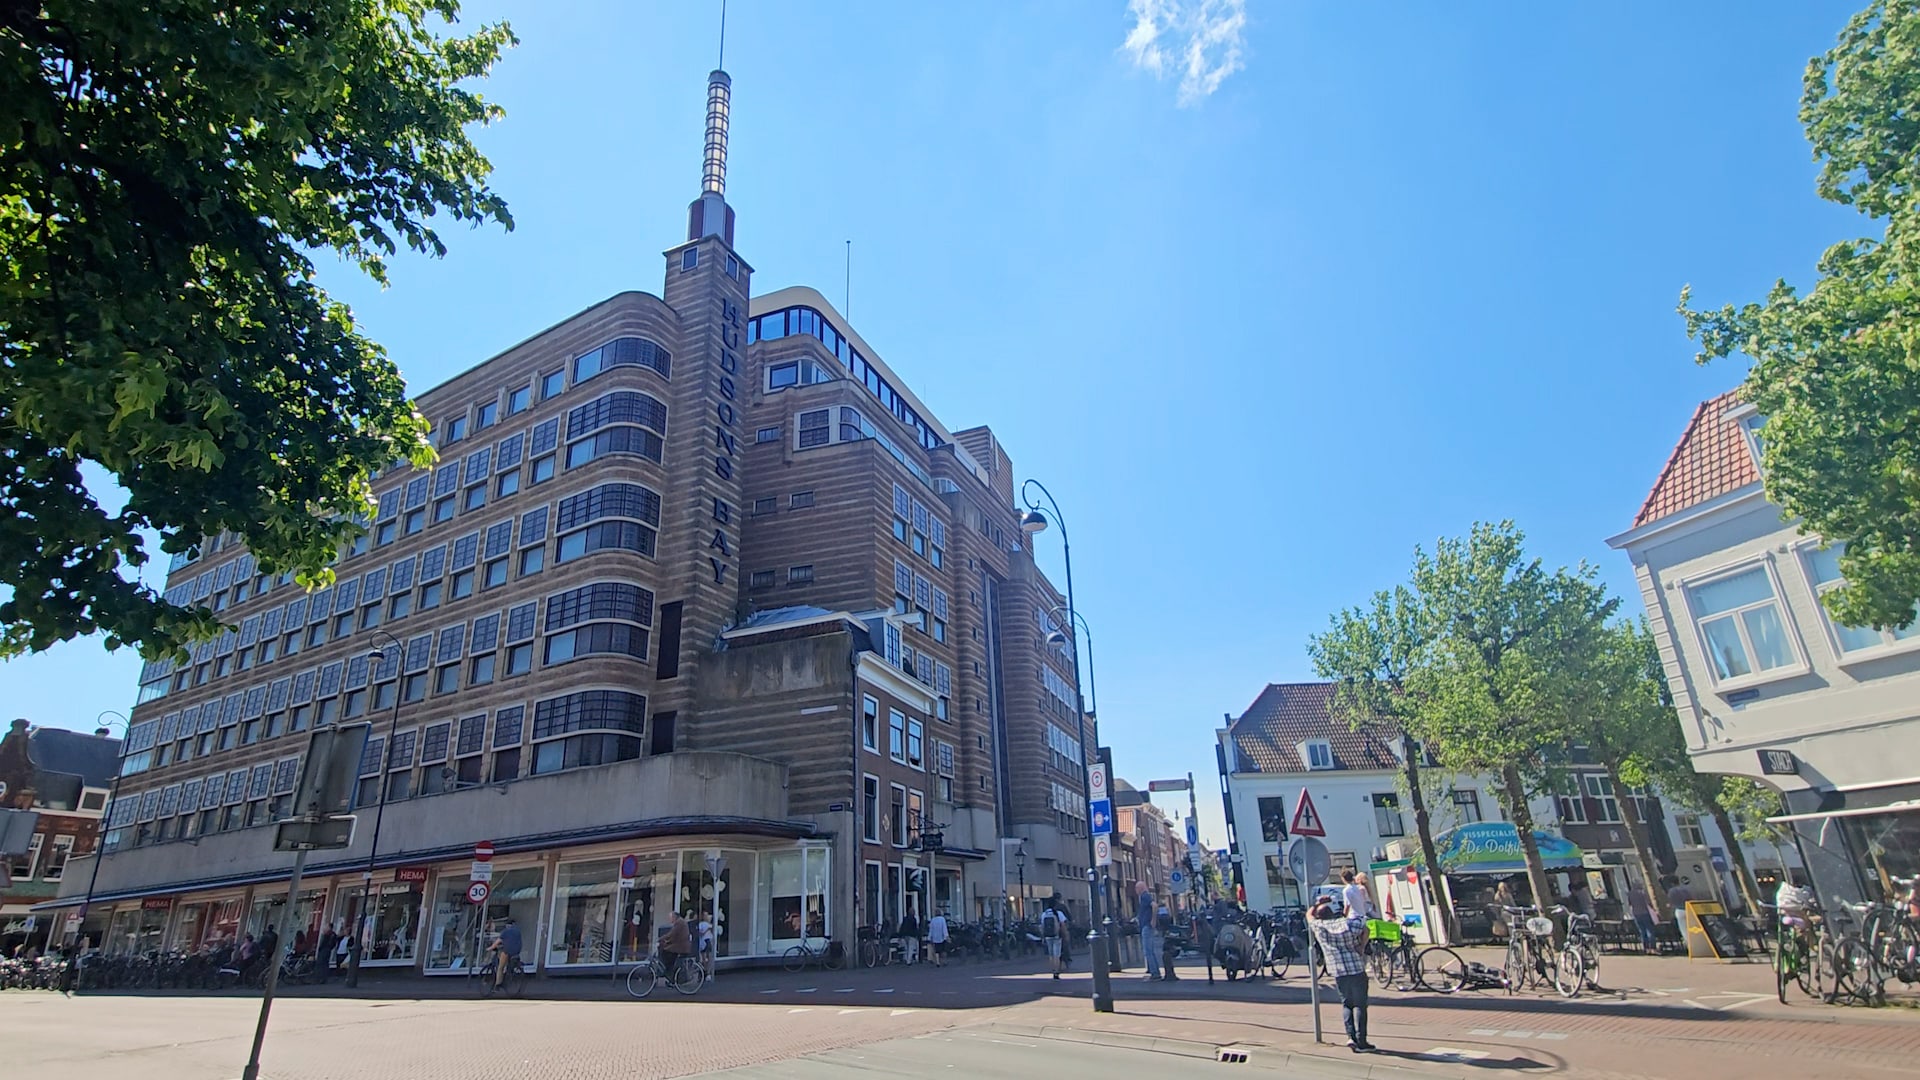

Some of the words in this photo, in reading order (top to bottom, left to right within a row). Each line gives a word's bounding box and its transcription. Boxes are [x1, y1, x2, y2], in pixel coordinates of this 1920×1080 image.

[714, 298, 740, 481] HUDSONS
[709, 496, 731, 585] BAY
[1767, 751, 1794, 770] STACH
[1463, 829, 1516, 838] VISSPECIALIS
[1466, 840, 1482, 854] De
[400, 871, 425, 880] HEMA
[471, 888, 486, 897] 30
[145, 900, 169, 908] HEMA
